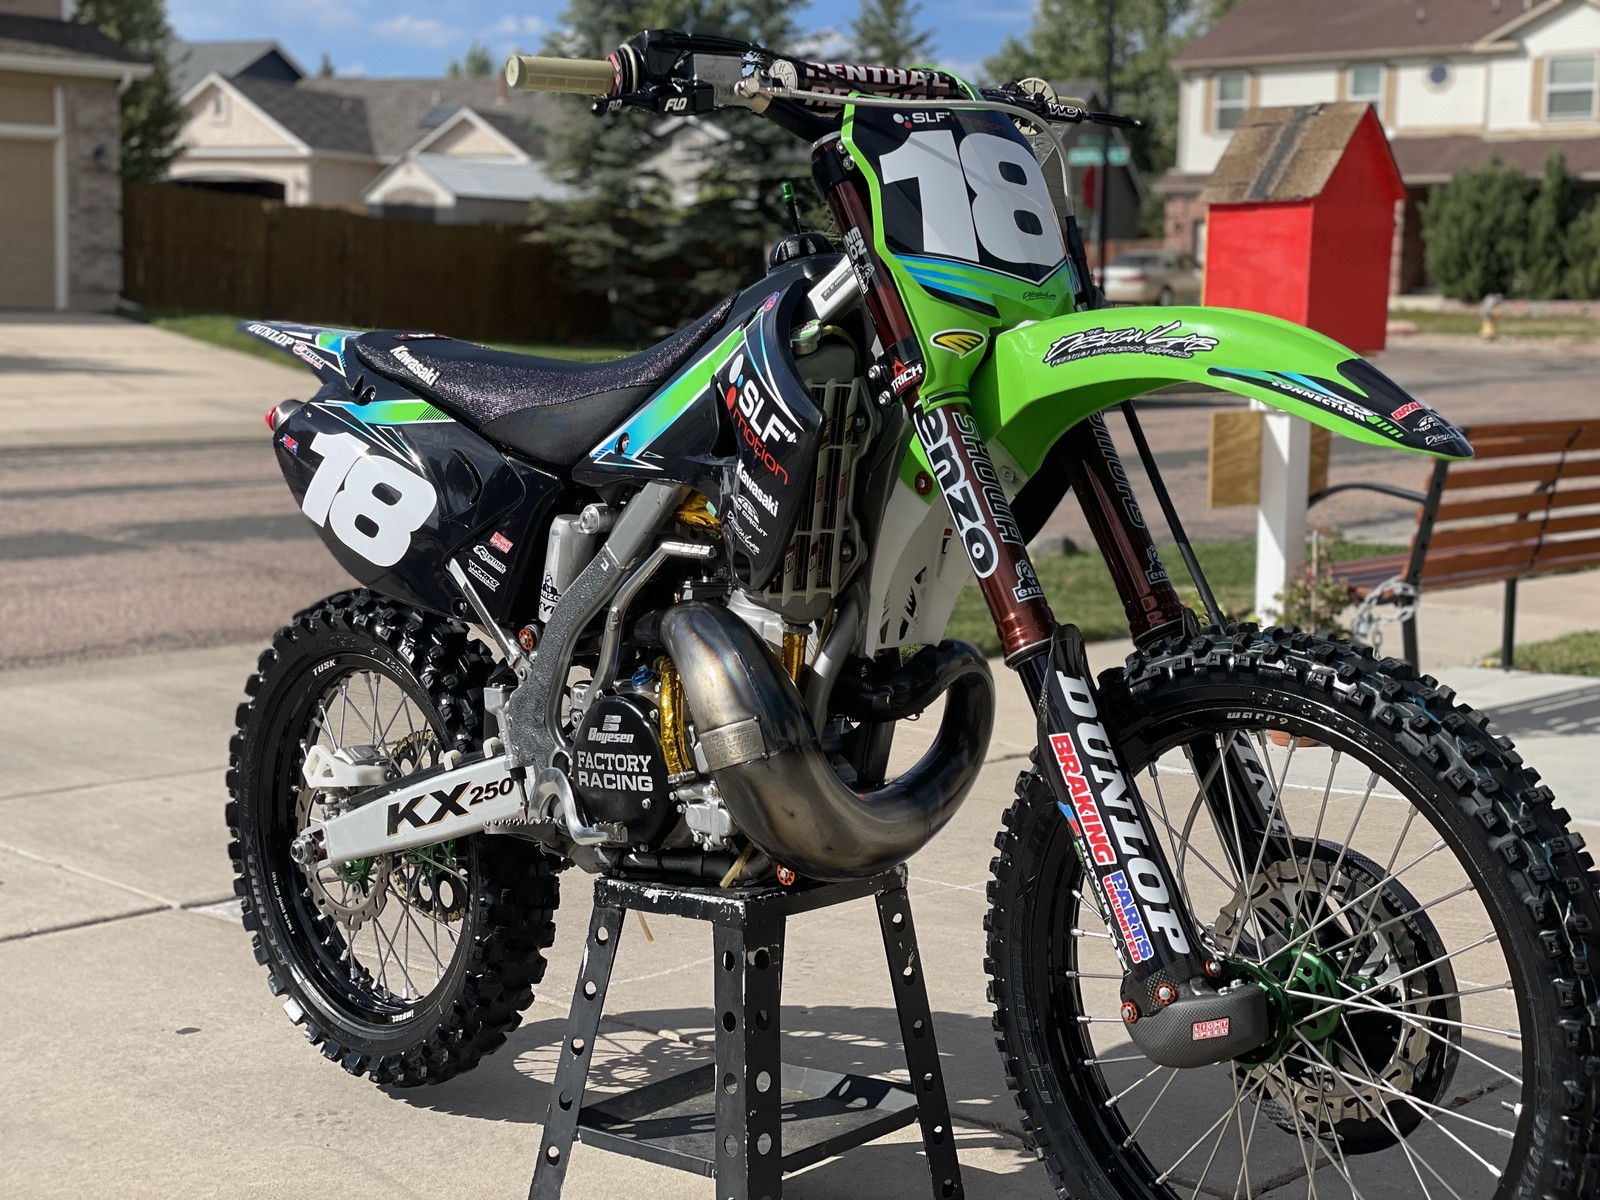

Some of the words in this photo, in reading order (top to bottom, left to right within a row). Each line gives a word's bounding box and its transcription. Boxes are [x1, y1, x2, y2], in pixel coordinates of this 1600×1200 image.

[805, 62, 949, 88] RENTHAL
[664, 97, 688, 112] FLO
[911, 111, 948, 124] SLF
[879, 129, 1067, 268] 18
[247, 323, 295, 347] DUNLOP
[1091, 344, 1143, 357] MOTOCROSS
[390, 345, 440, 386] Kawasaki
[891, 364, 923, 392] TRICK
[739, 379, 785, 443] SLF
[733, 408, 789, 485] motion
[736, 459, 779, 518] Kawasaki
[912, 400, 999, 579] enzo
[952, 411, 1026, 547] SHOWA
[301, 432, 437, 567] 18
[740, 509, 768, 538] CIRCUIT
[469, 561, 500, 587] WORKS
[312, 659, 336, 676] TUSK
[588, 727, 635, 744] Boyesen
[577, 751, 652, 773] FACTORY
[578, 770, 653, 792] RACING
[1051, 734, 1116, 865] BRAKING
[1056, 670, 1190, 954] DUNLOP
[1078, 836, 1111, 917] PISTONS
[1104, 877, 1141, 962] UNLIMITED
[1110, 871, 1152, 959] PARTS
[1194, 1020, 1228, 1031] LIGHT
[1194, 1029, 1228, 1039] SPEED
